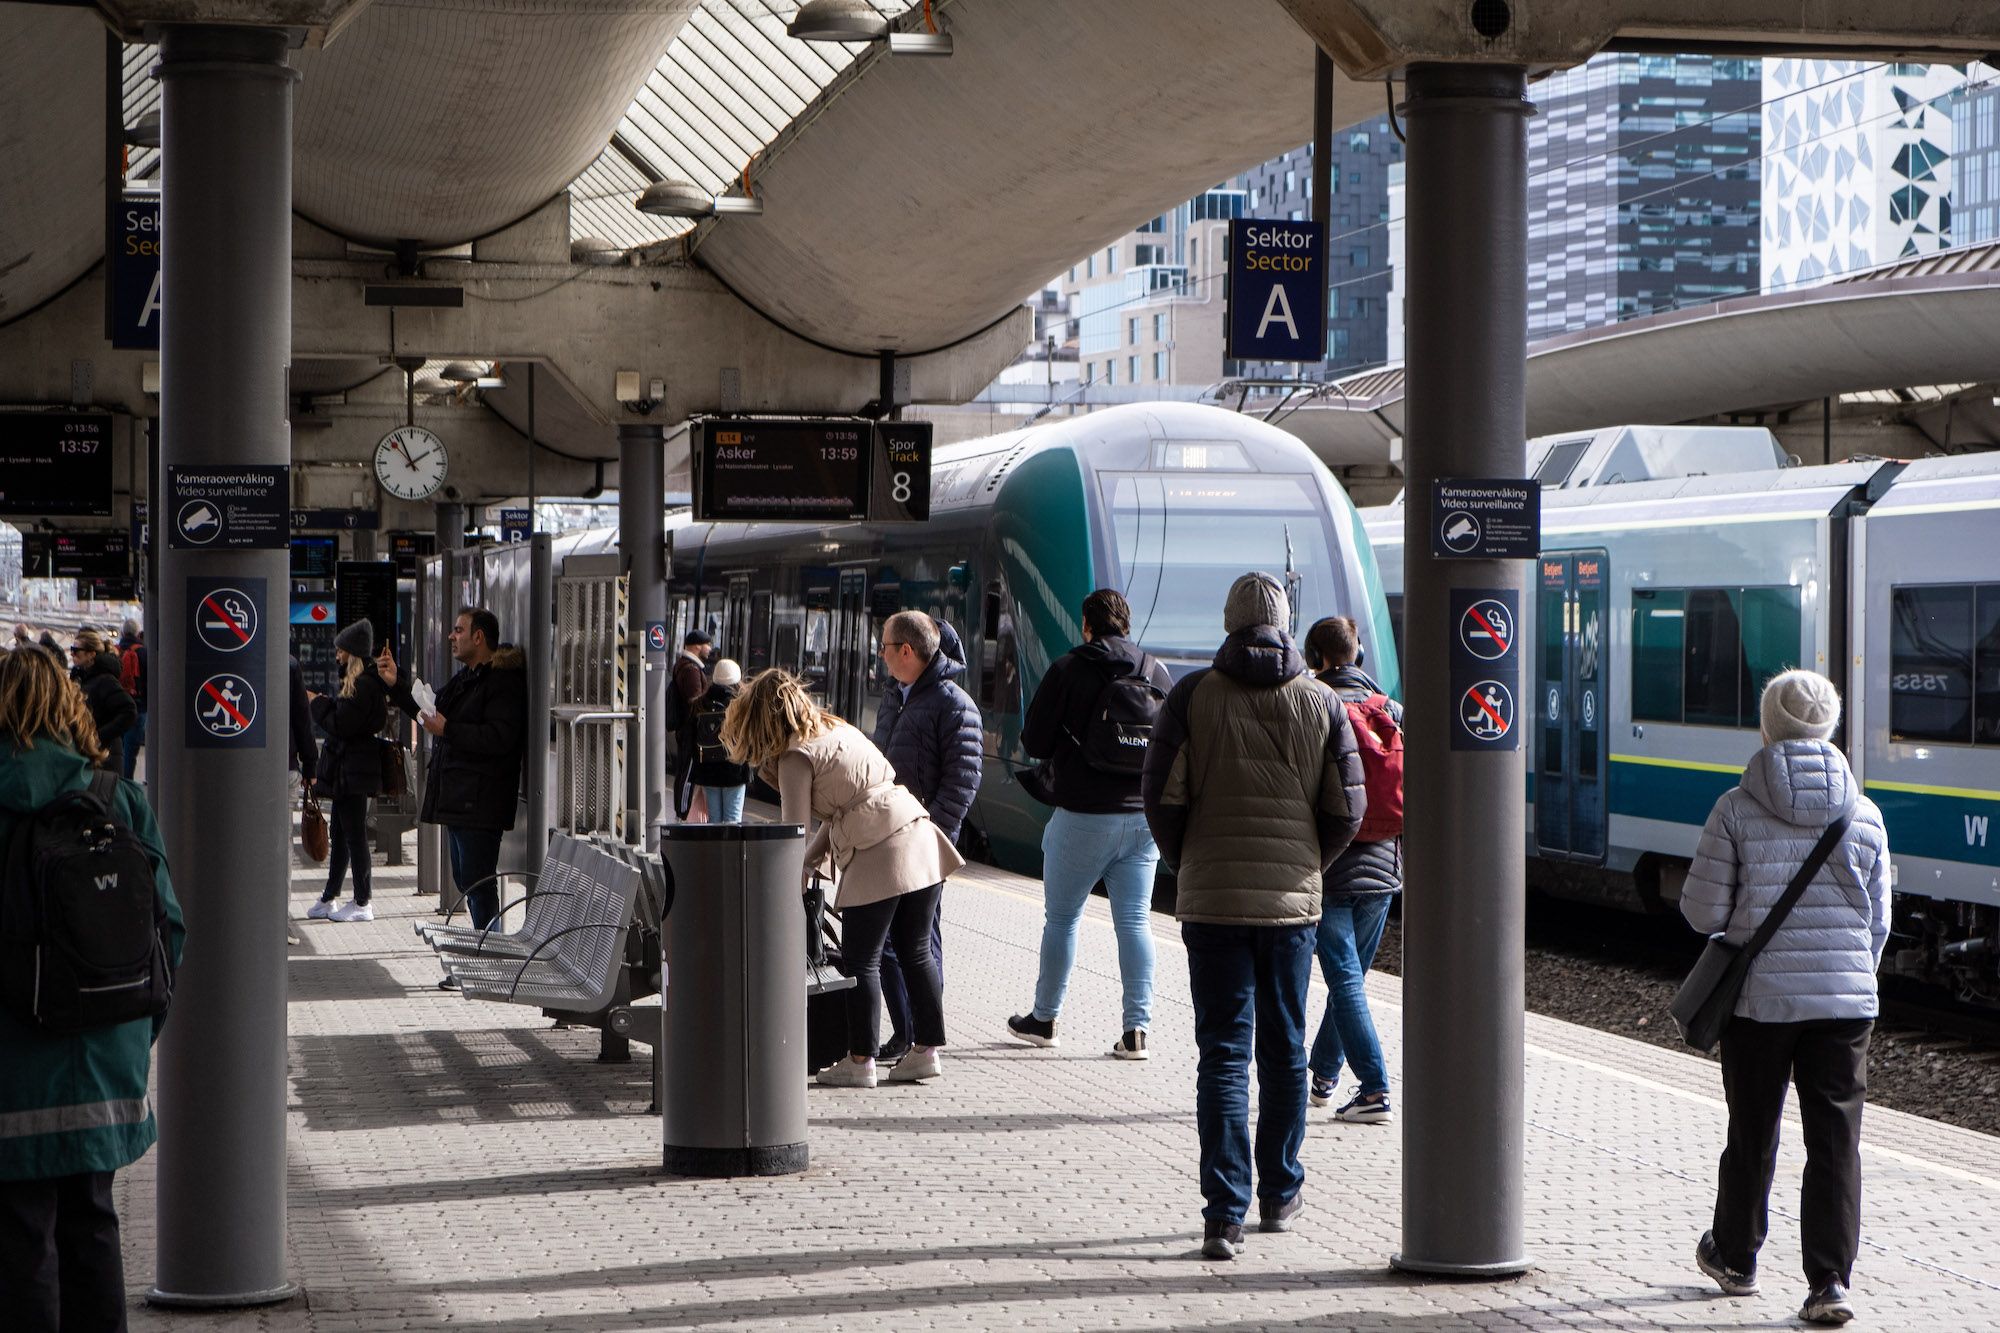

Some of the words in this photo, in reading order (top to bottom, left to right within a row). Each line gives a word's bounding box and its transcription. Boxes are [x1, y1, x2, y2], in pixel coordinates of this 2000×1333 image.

[1246, 227, 1313, 249] Sektor
[1246, 250, 1313, 271] Sector
[1255, 283, 1300, 340] A
[76, 424, 100, 433] 13:56
[836, 432, 859, 440] 13:56
[59, 440, 100, 453] 13:57
[889, 439, 917, 452] Spor
[716, 445, 757, 460] Asker
[820, 447, 859, 461] 13:59
[889, 451, 921, 463] Track
[176, 473, 275, 487] Kameraovervåking
[176, 486, 206, 496] Video
[208, 486, 269, 496] surveillance
[892, 471, 911, 503] 8
[1441, 487, 1527, 500] Kameraovervåking
[1441, 498, 1468, 509] Video
[1470, 500, 1525, 510] surveillance
[504, 510, 529, 520] Sektor
[32, 554, 41, 571] 7
[1118, 735, 1150, 747] VALENT
